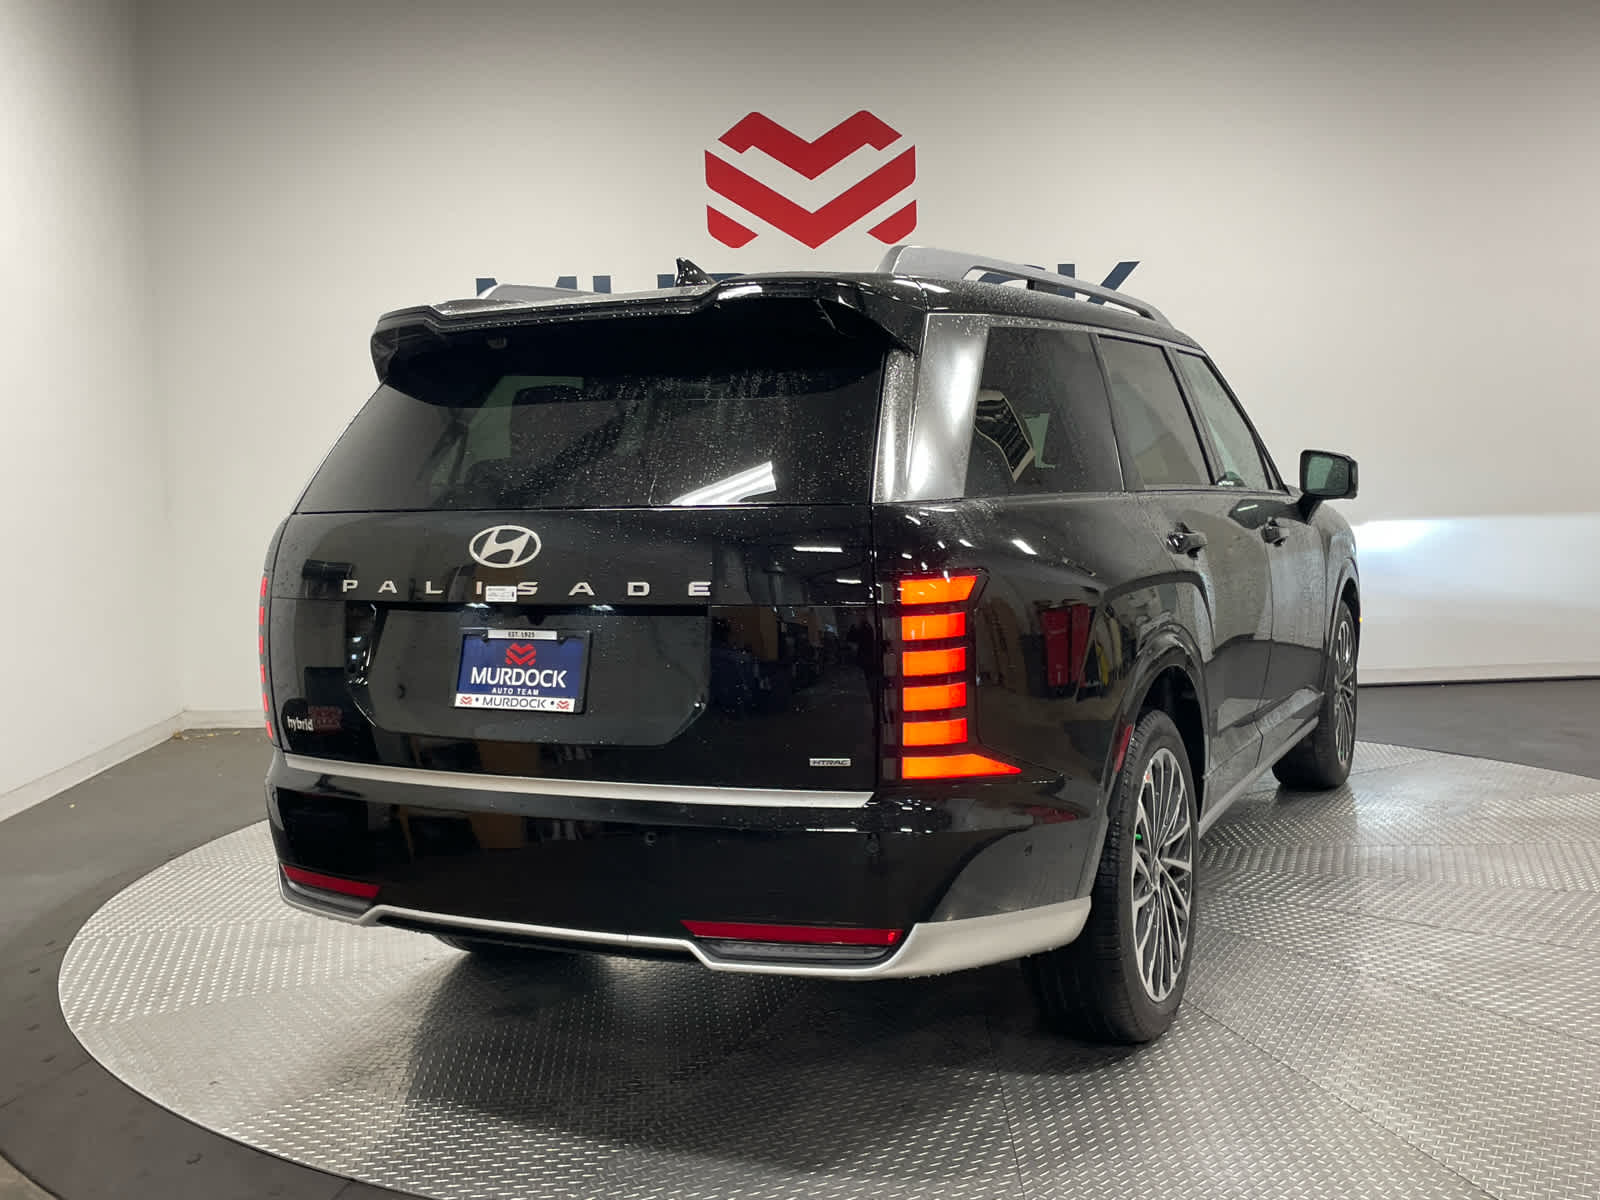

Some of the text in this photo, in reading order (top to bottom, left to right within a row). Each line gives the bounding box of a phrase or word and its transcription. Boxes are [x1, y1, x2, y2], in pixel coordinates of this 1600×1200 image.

[342, 579, 712, 596] PALISADE
[470, 667, 568, 688] MURDOCK
[517, 688, 539, 696] TEAM
[481, 697, 547, 709] MURDOCK
[286, 716, 314, 731] hybrid
